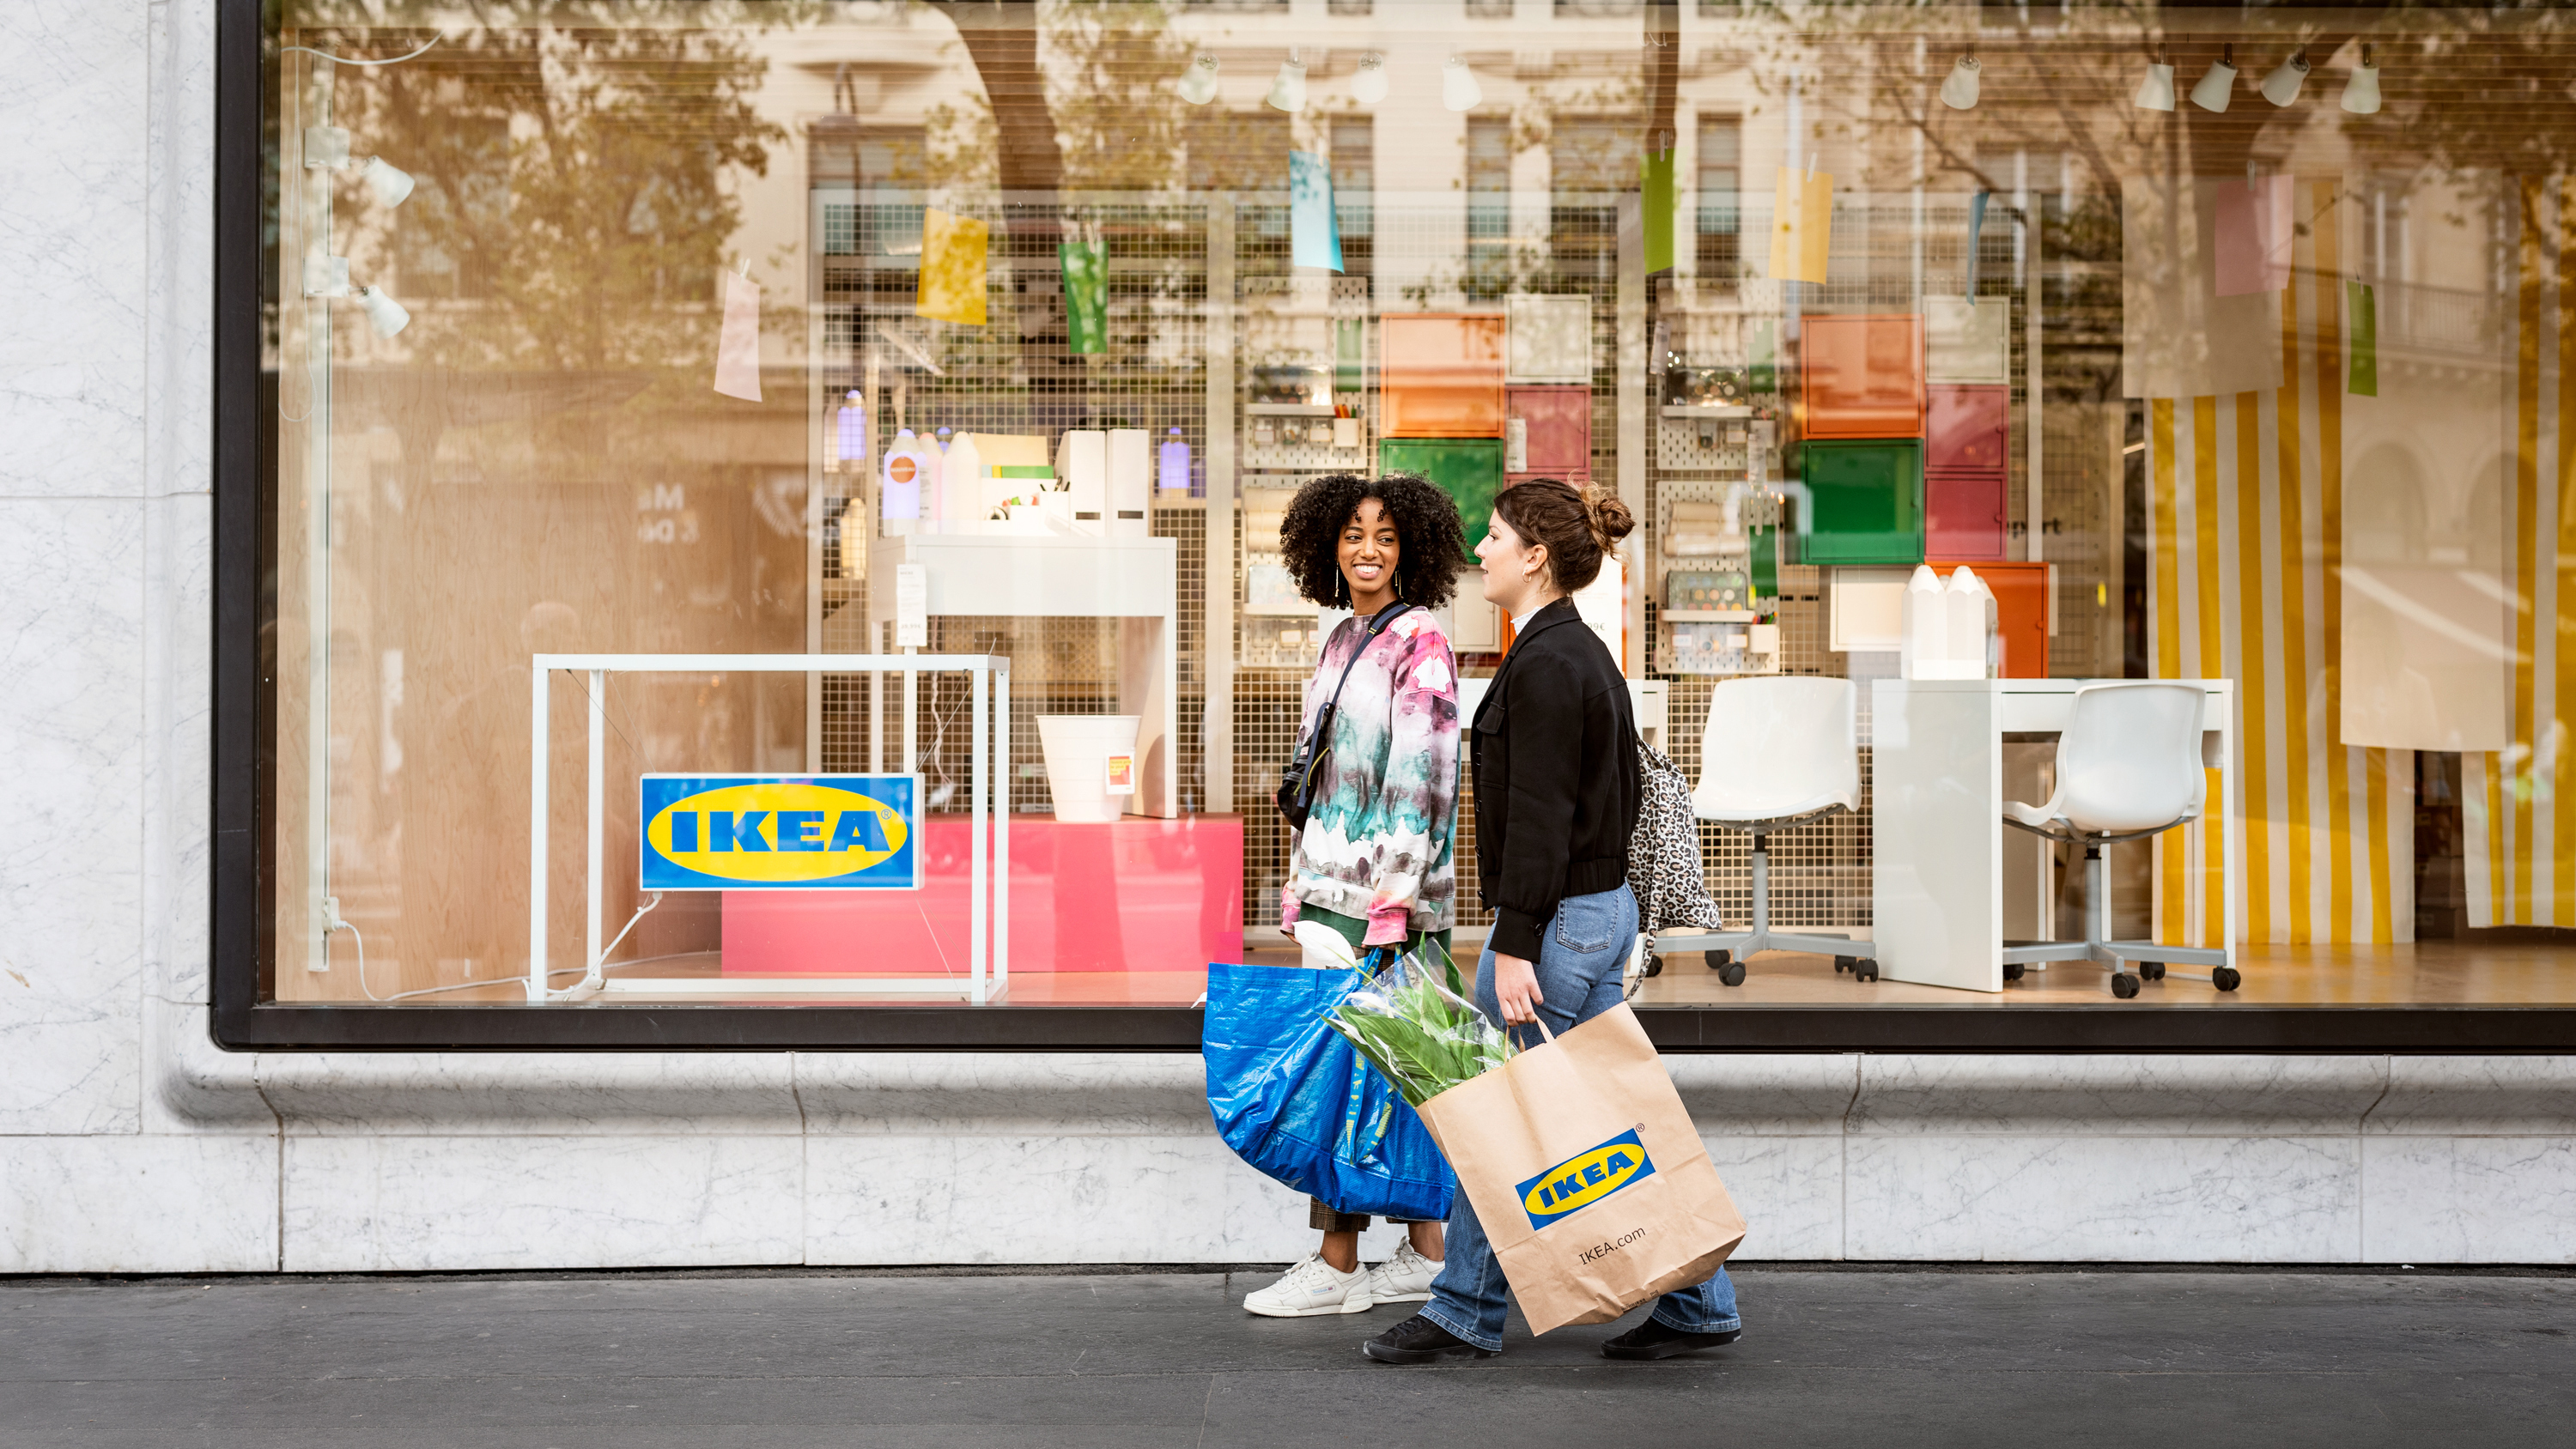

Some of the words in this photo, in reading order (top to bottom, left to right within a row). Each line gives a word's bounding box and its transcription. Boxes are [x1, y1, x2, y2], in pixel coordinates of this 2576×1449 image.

[671, 810, 891, 852] IKEA
[1538, 1150, 1635, 1209] IKEA
[1578, 1227, 1646, 1266] IKEA.com
